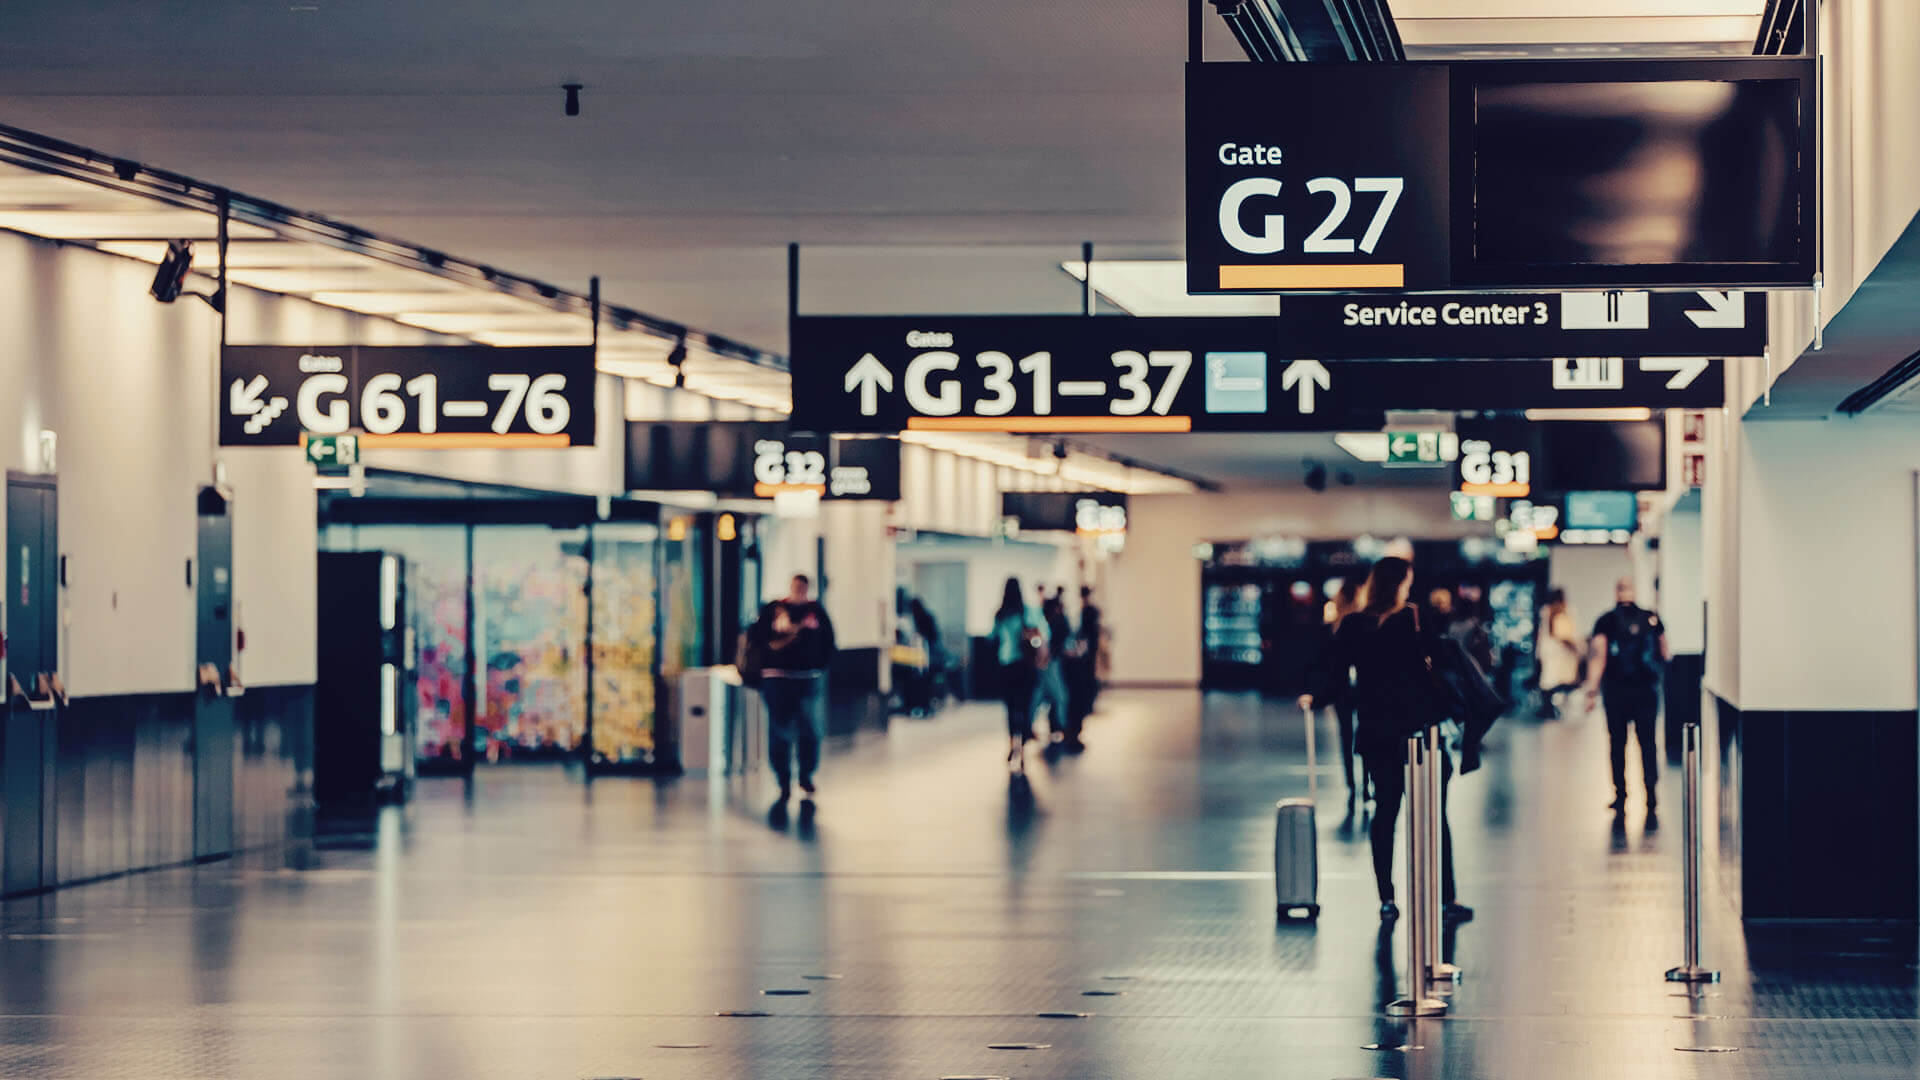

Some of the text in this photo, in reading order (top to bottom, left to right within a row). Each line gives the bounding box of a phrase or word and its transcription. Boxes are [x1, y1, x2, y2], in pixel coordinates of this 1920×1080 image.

[1218, 142, 1282, 166] Gate
[1218, 177, 1404, 255] G 27
[1343, 300, 1549, 326] Service Center 3
[296, 373, 350, 434] G
[904, 350, 962, 416] G
